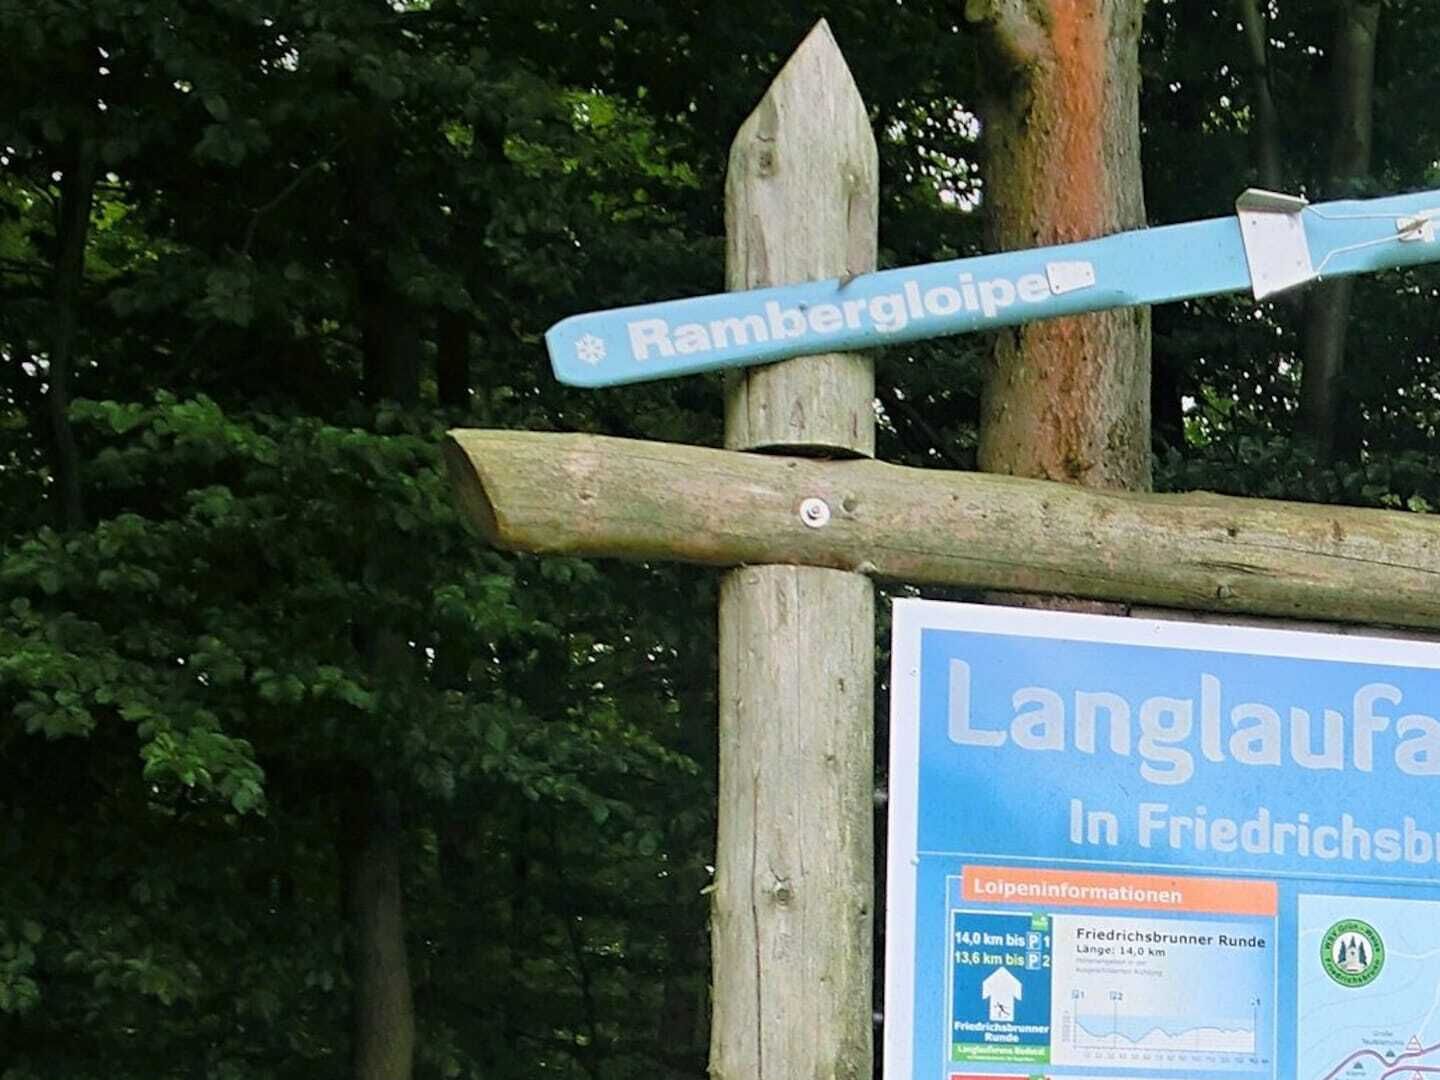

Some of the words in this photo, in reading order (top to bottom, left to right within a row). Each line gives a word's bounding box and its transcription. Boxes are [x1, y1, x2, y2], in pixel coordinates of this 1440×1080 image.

[627, 271, 1050, 361] Rambergloipe
[1070, 799, 1119, 846] In
[973, 878, 1183, 904] Loipeninformationen
[955, 931, 981, 946] 14,0
[983, 933, 1003, 946] km
[1006, 934, 1025, 946] bis
[1044, 936, 1050, 947] 1
[1076, 928, 1214, 946] Friedrichsbrunner
[1218, 935, 1267, 949] Runde
[954, 951, 980, 965] 13,6
[982, 953, 1003, 965] km
[1005, 954, 1025, 966] bis
[1042, 956, 1051, 968] 2
[1119, 947, 1145, 957] 14,0
[1148, 947, 1166, 957] km
[954, 1021, 1049, 1034] Friedrichsbrunner
[984, 1032, 1019, 1042] Runde
